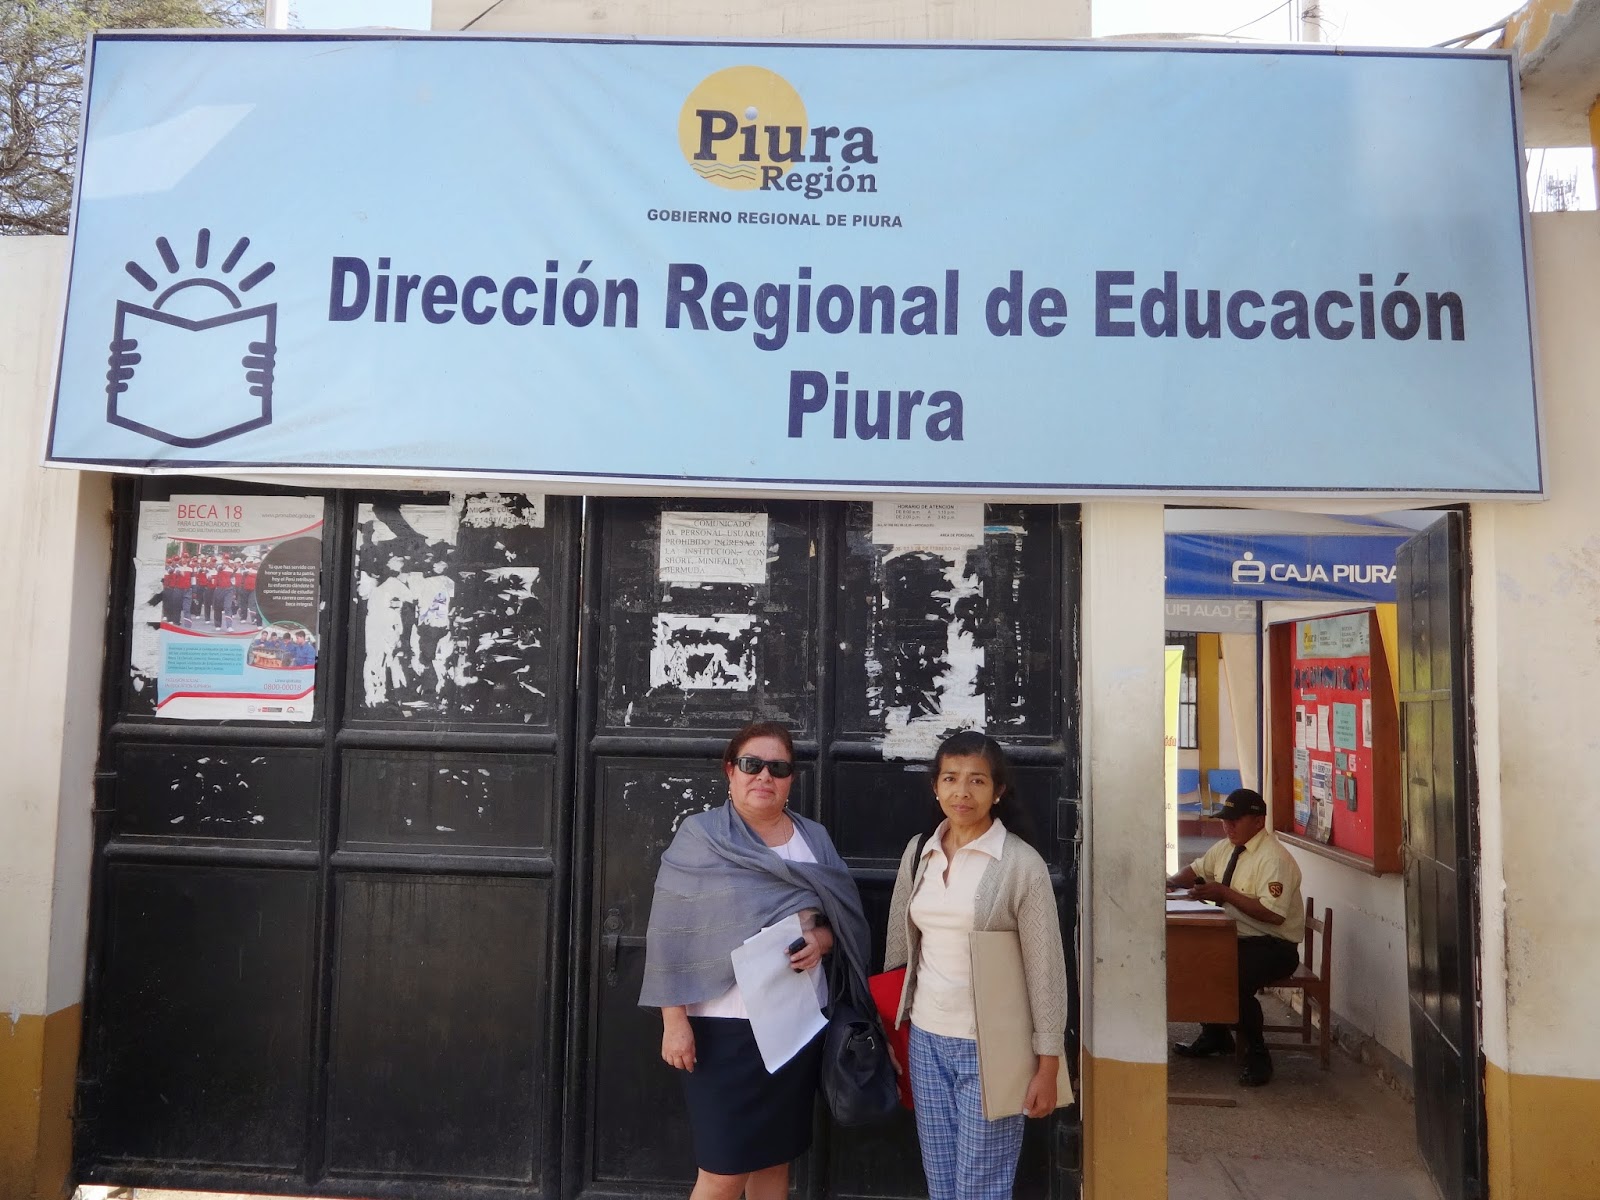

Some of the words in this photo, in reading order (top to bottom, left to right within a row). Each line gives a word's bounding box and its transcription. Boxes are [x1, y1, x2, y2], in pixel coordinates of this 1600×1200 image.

[693, 106, 879, 165] Piura
[759, 165, 878, 200] Región
[647, 208, 732, 223] GOBIERNO
[737, 211, 821, 226] REGIONAL
[826, 213, 847, 227] DE
[852, 214, 903, 228] PIURA
[328, 256, 639, 328] Dirección
[665, 263, 960, 352] Regional
[985, 269, 1068, 338] de
[1095, 270, 1465, 341] Educación
[788, 370, 964, 442] Piura
[177, 504, 219, 519] BECA
[224, 505, 243, 520] 18
[694, 520, 751, 528] COMUNICADO
[680, 529, 723, 537] PERSONAL
[665, 538, 710, 546] PROHIBIDO
[714, 539, 755, 547] INGRESAR
[664, 566, 705, 574] BERMUDA
[1270, 563, 1329, 582] CAJA
[263, 683, 302, 691] 0800-00018
